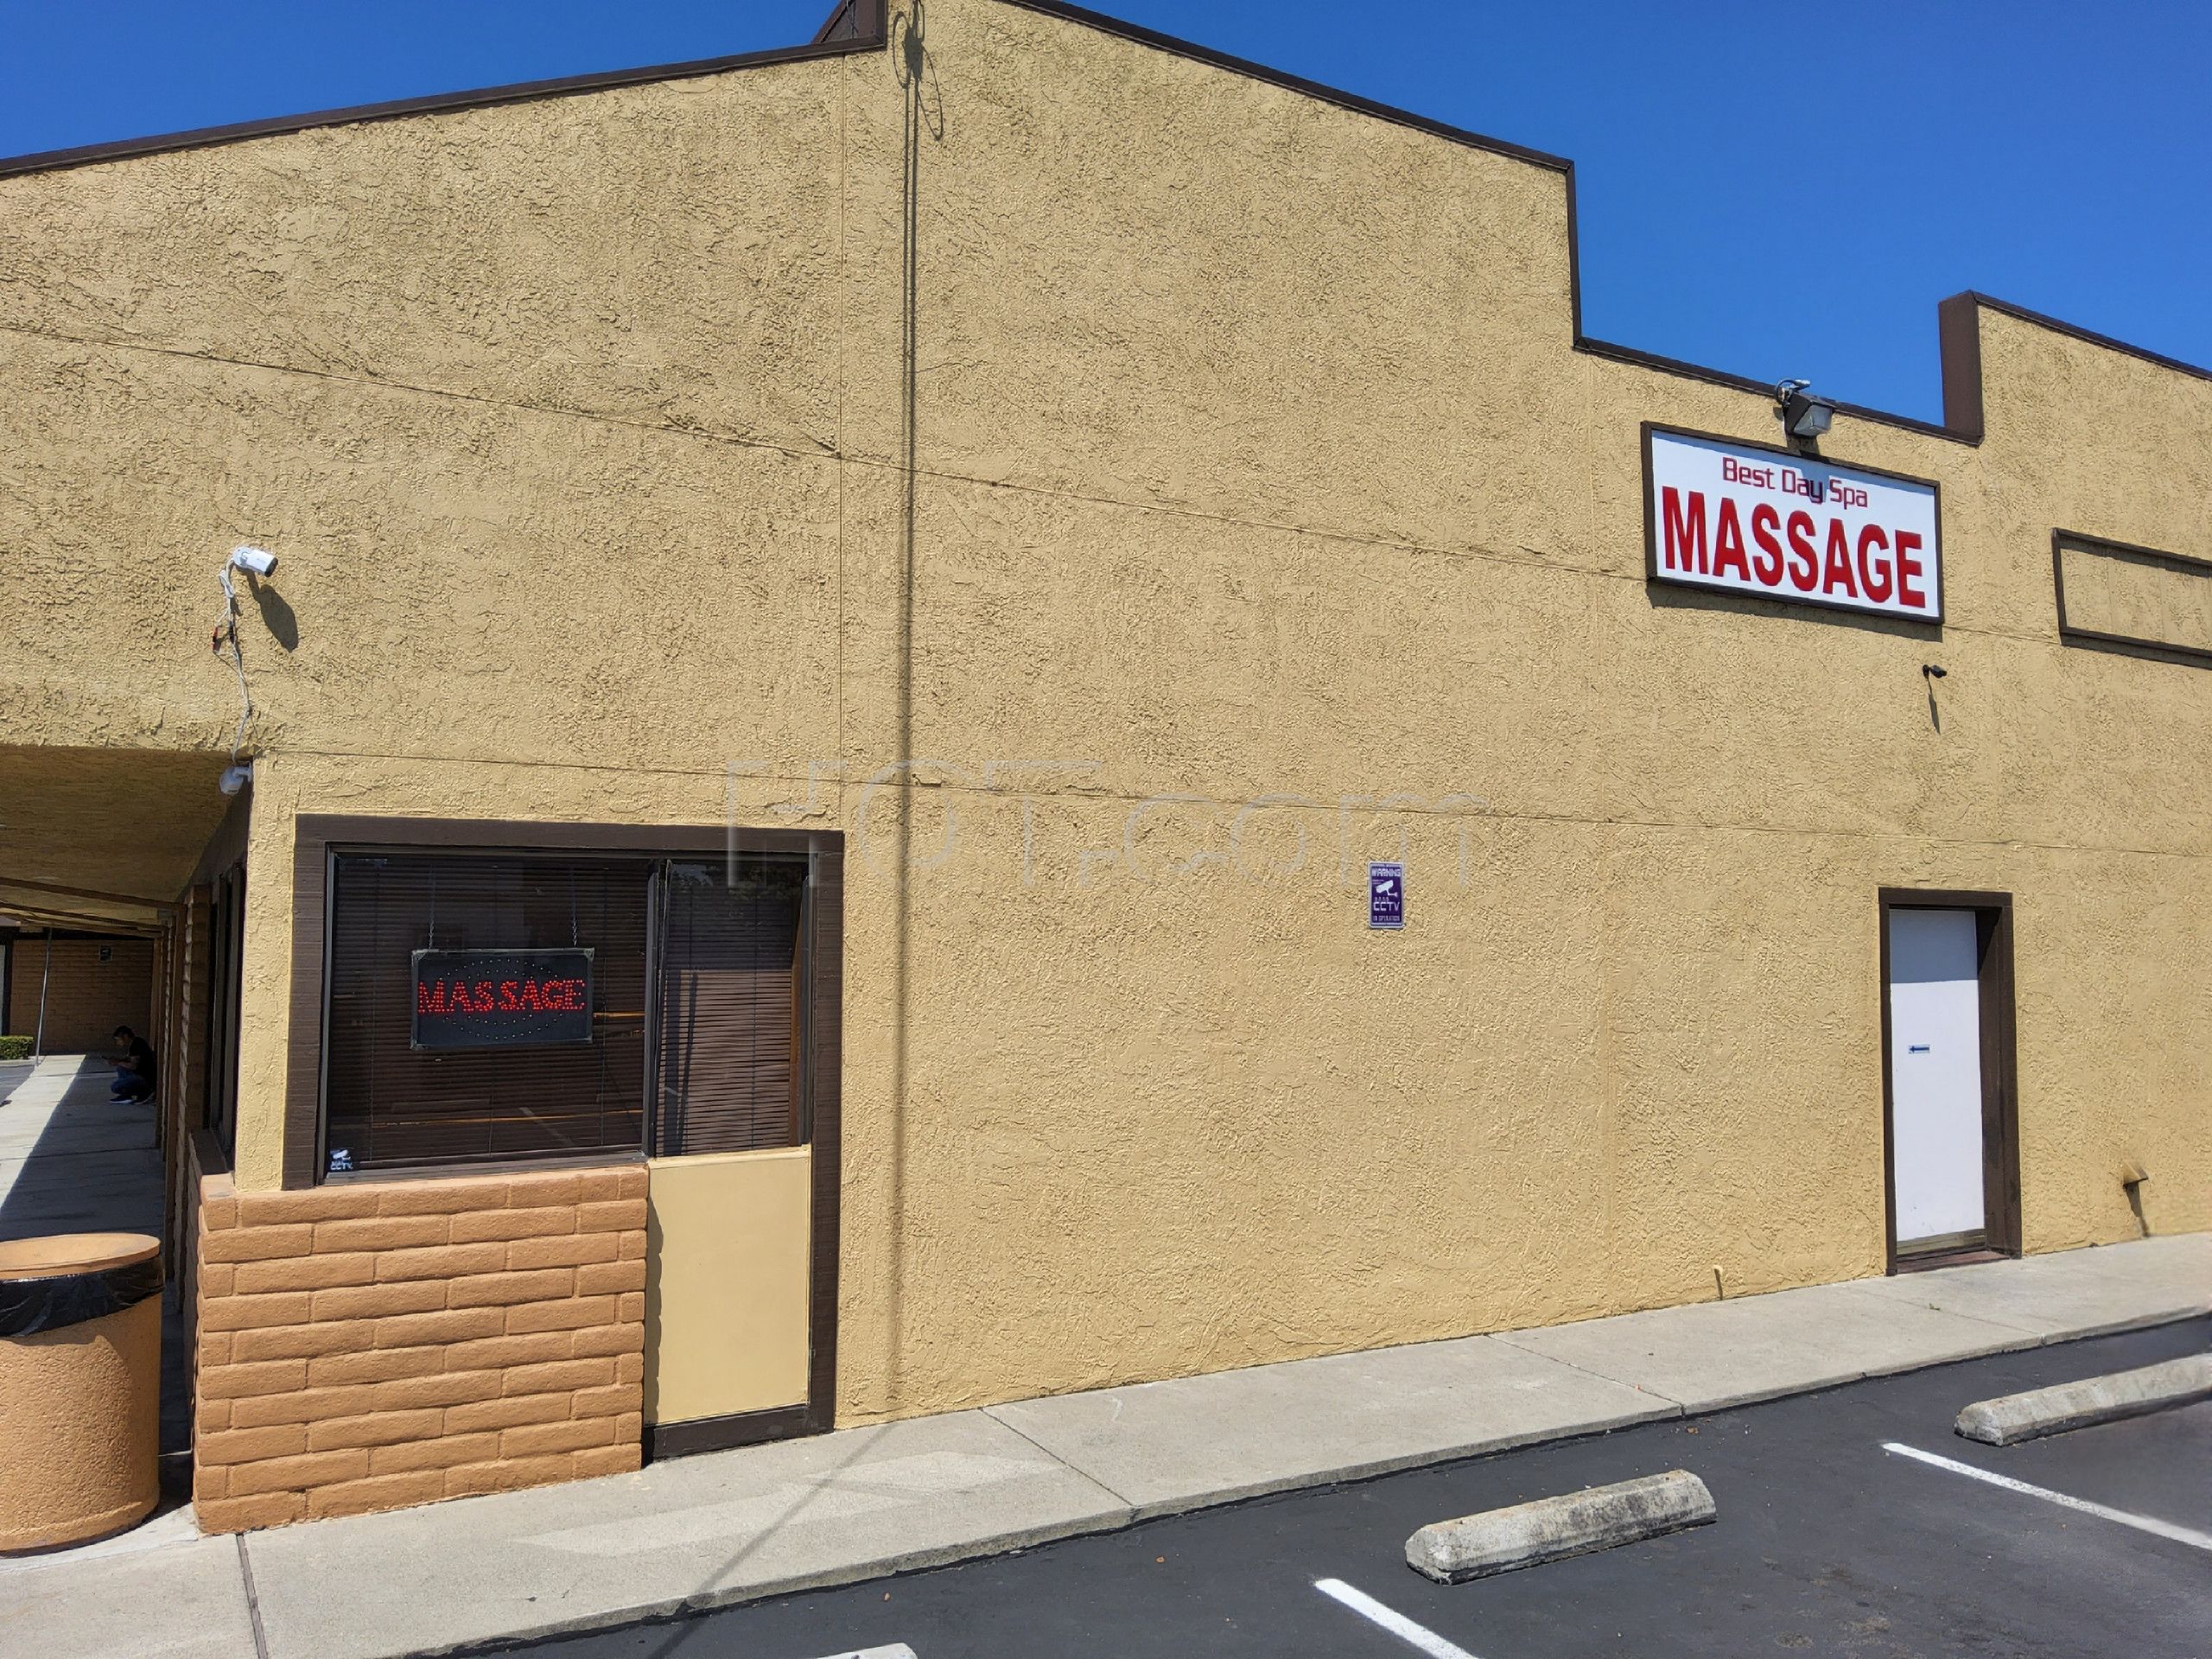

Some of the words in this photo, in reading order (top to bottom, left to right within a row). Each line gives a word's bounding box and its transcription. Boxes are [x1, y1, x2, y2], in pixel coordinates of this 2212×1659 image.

[1722, 456, 1775, 490] Best
[1782, 468, 1824, 504] Day
[1828, 479, 1868, 509] Spa
[1662, 486, 1926, 608] MASSAGE
[1373, 901, 1400, 912] CCTV
[417, 979, 586, 1014] MASSAGE
